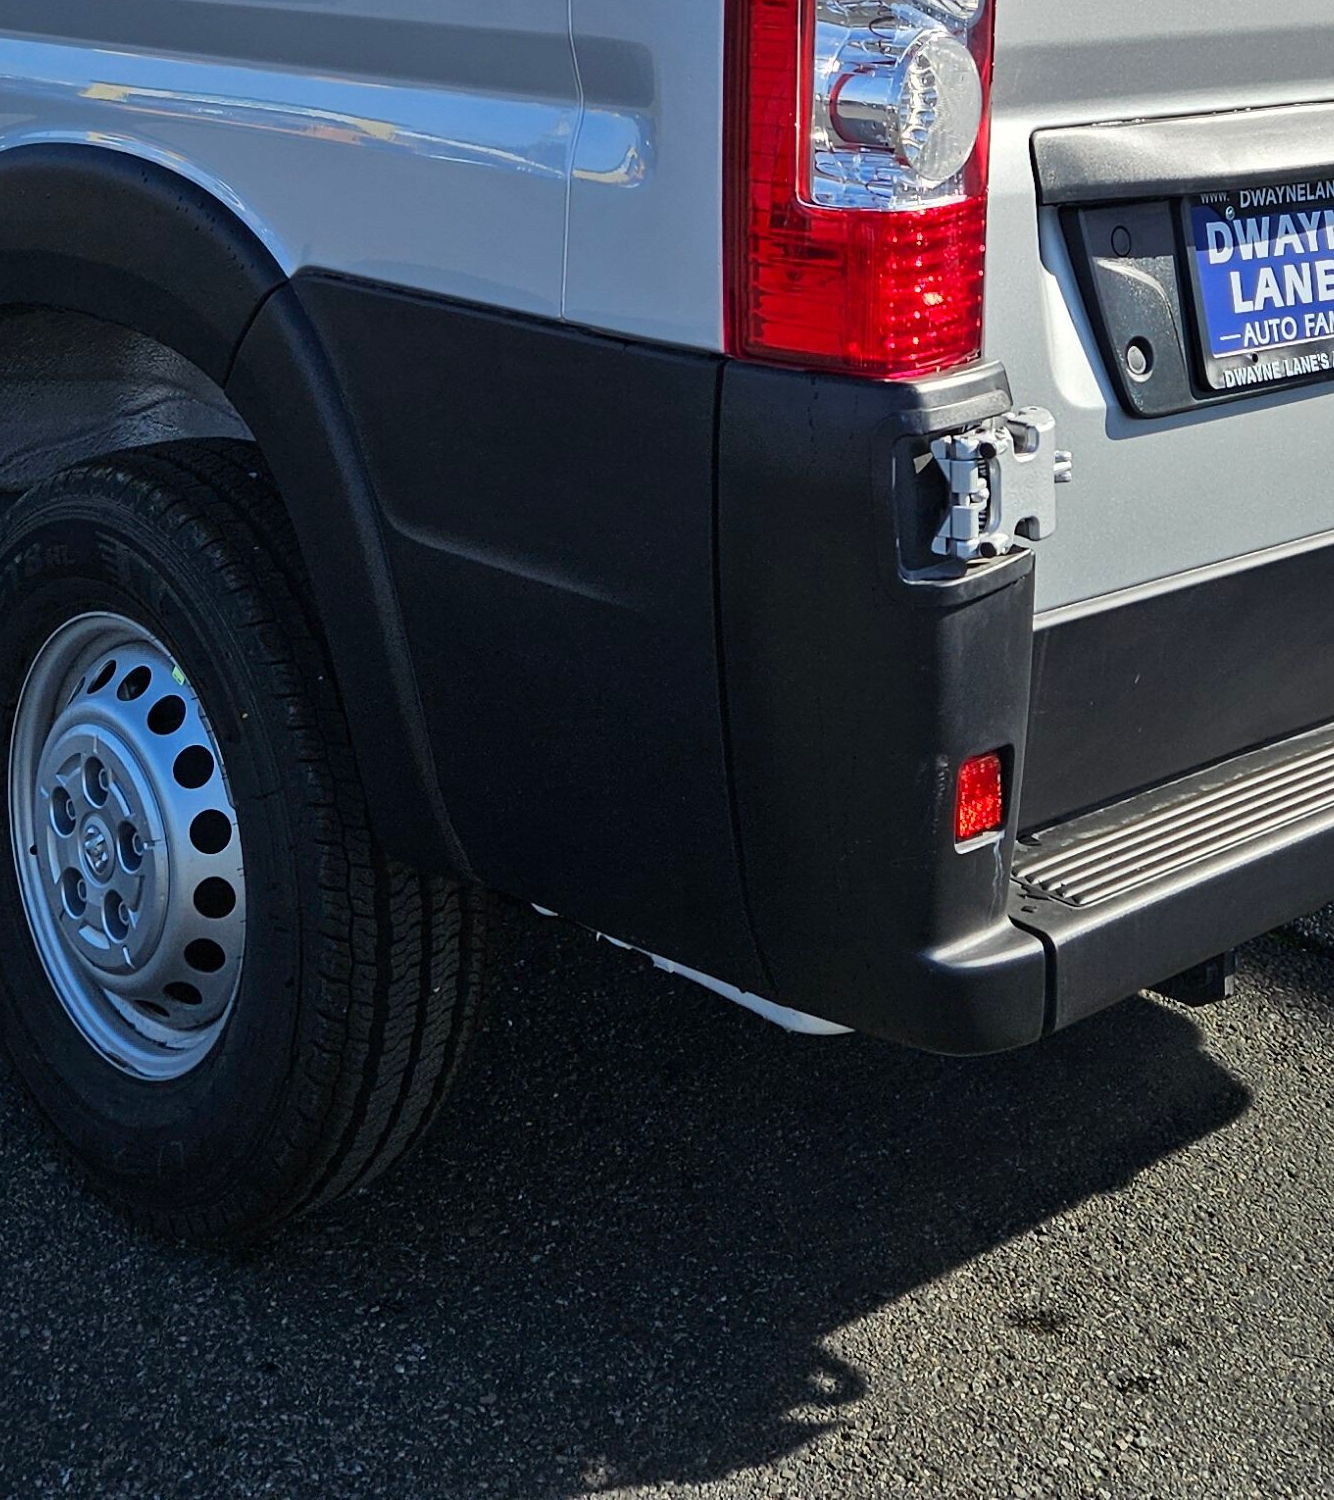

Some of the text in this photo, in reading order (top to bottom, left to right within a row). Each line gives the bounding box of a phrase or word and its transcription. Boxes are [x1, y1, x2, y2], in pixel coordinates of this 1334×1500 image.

[1243, 316, 1297, 347] AUTO
[1224, 361, 1283, 388] DWAYNE
[1284, 352, 1329, 378] LANE'S
